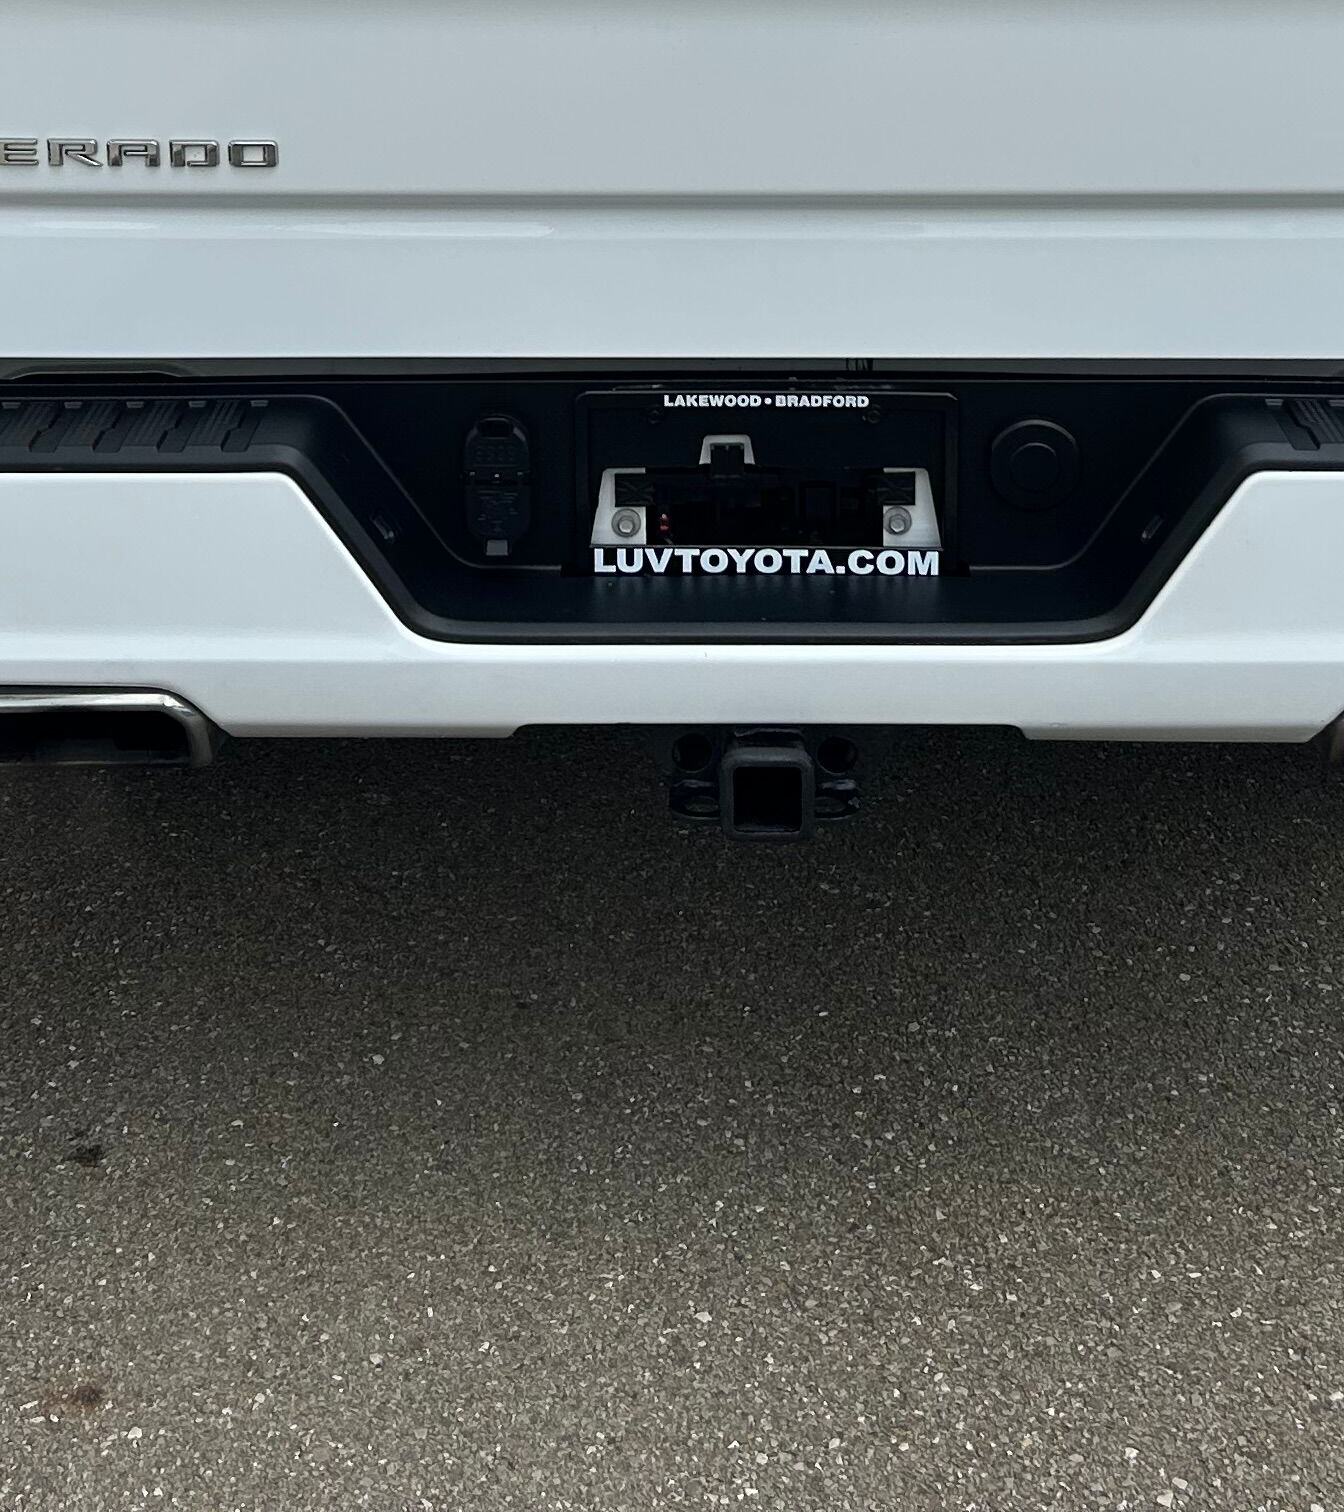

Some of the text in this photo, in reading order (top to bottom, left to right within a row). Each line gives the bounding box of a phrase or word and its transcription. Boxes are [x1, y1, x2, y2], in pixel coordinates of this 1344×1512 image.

[663, 394, 870, 408] LAKEWOOD BRADFORD
[593, 547, 940, 576] LUVTOYOTA.COM
